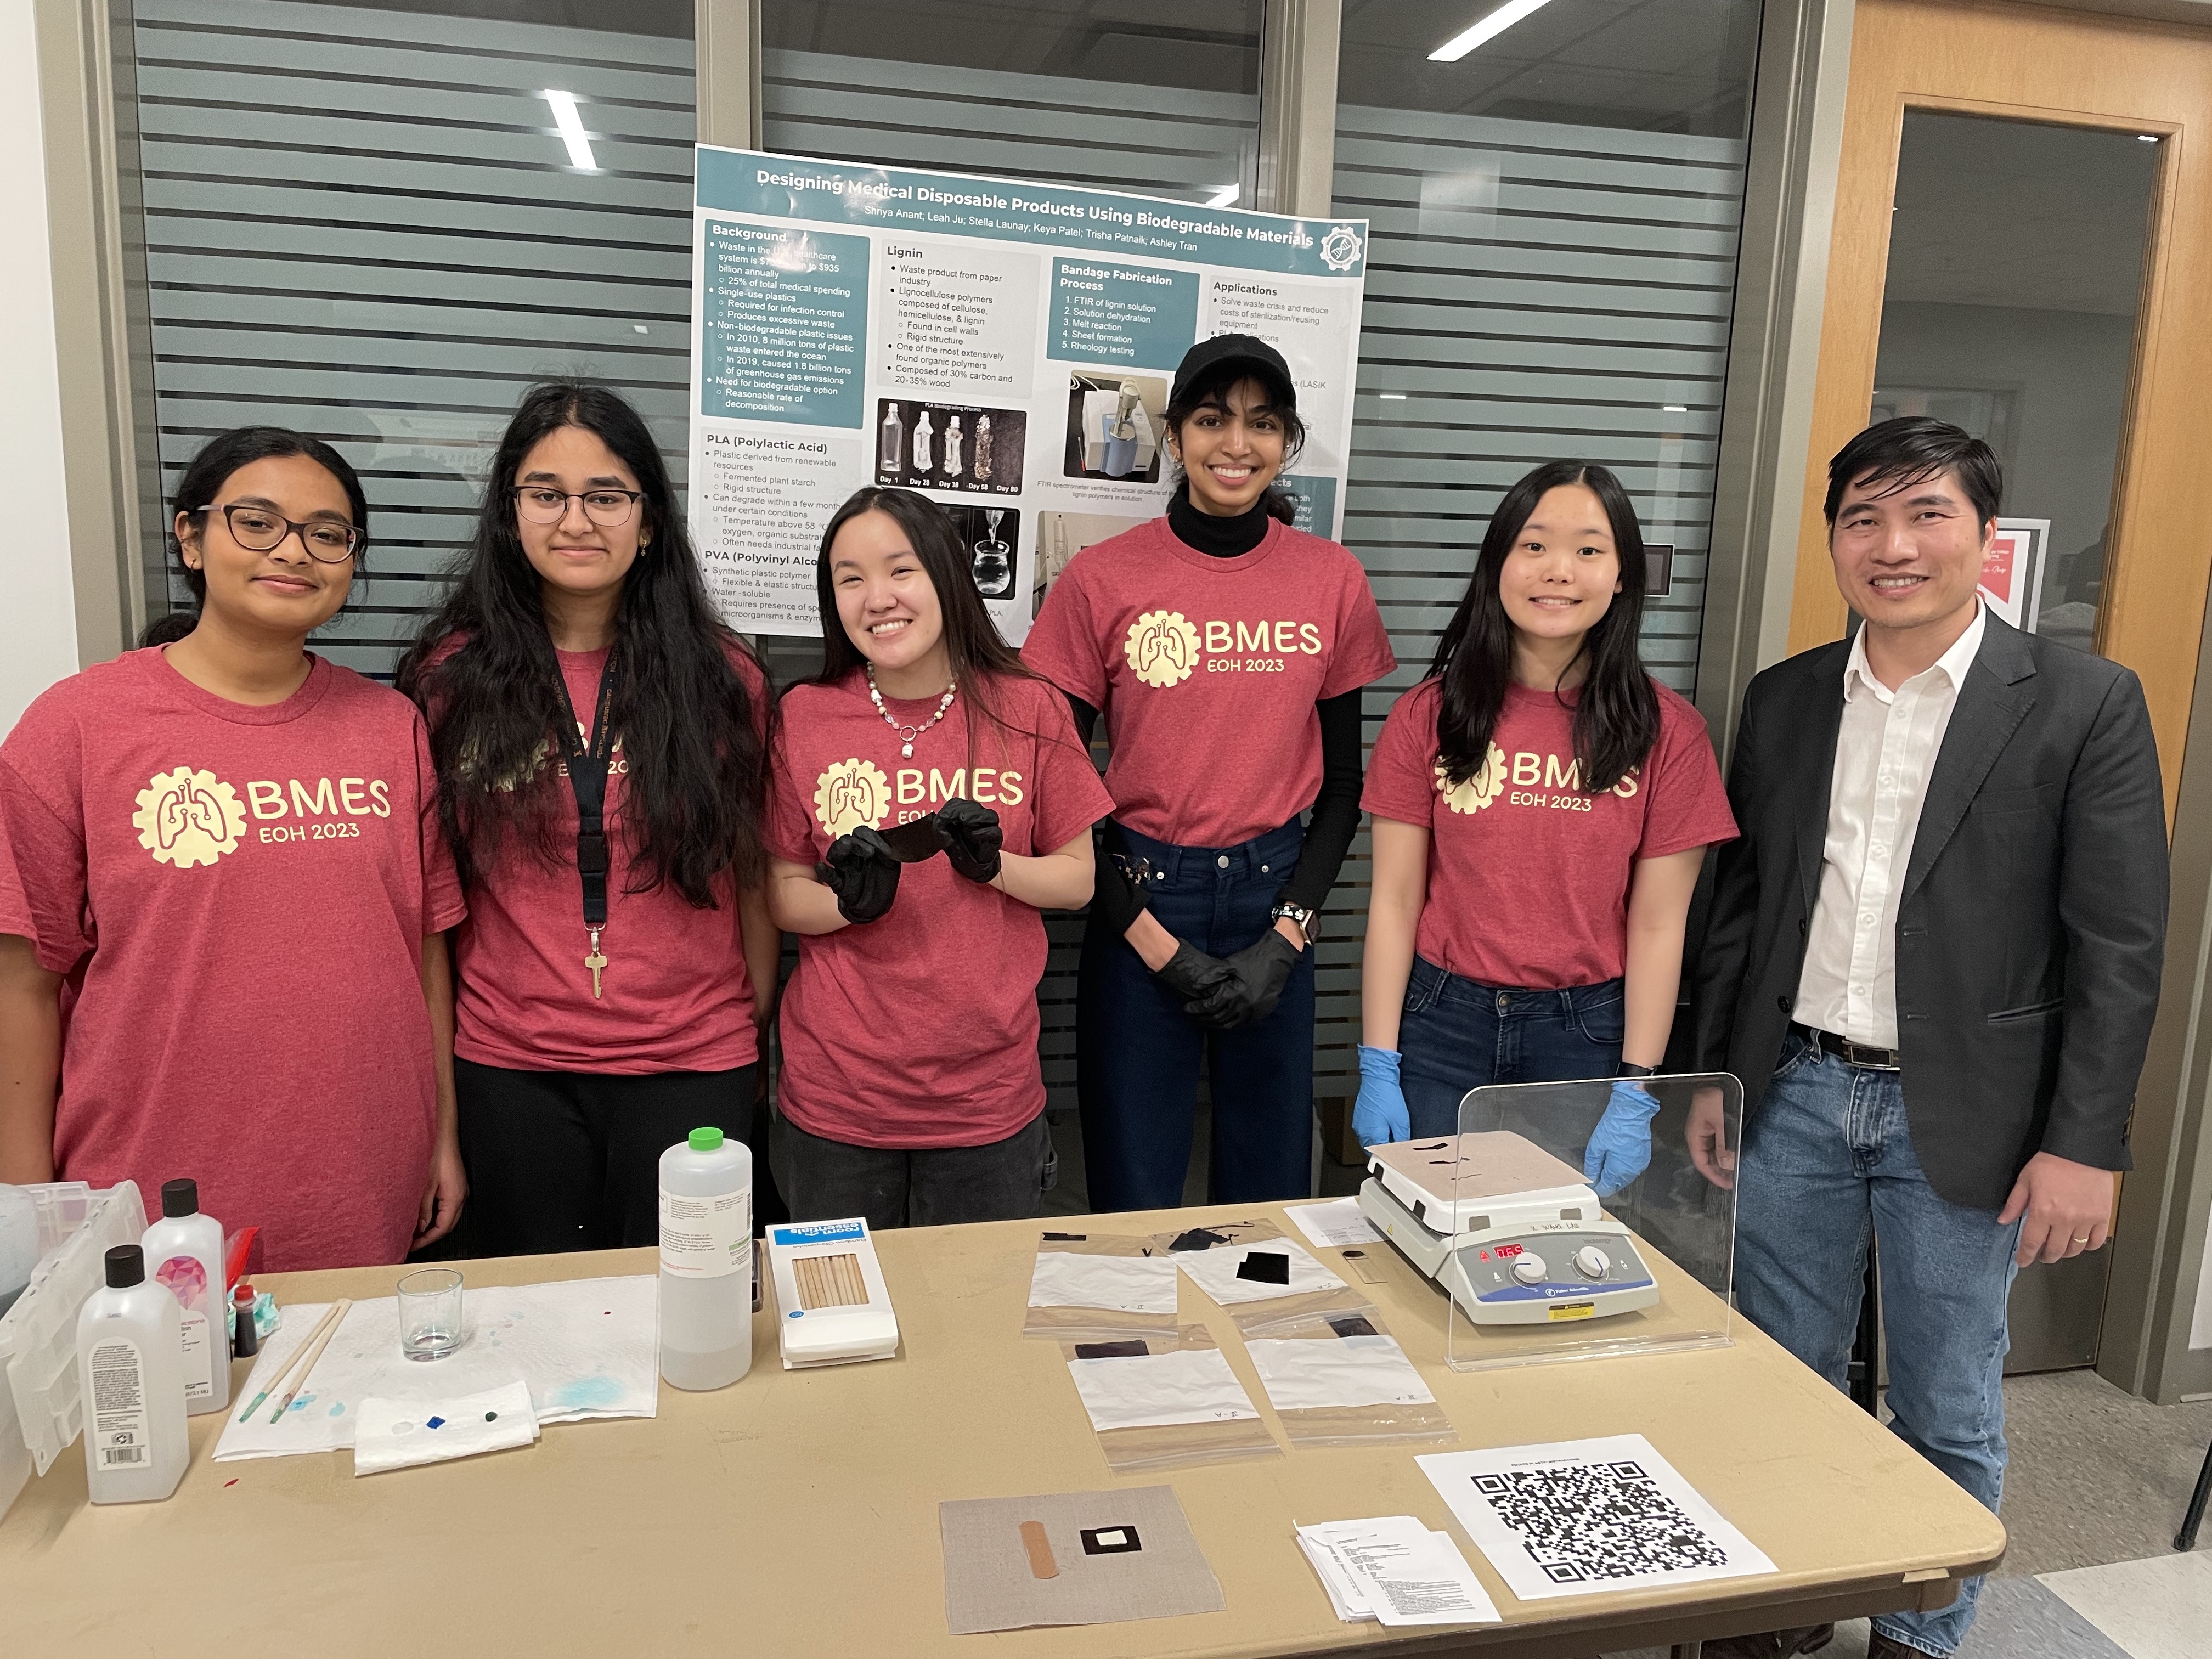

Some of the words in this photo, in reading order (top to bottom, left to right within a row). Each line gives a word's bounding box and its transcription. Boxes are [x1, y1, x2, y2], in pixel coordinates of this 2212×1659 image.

[757, 170, 843, 194] Designing
[848, 180, 912, 199] Medical
[917, 187, 1007, 209] Disposable
[1011, 198, 1084, 218] Products
[1089, 206, 1132, 227] Using
[1137, 212, 1243, 238] Biodegradable
[1246, 227, 1313, 249] Materials
[713, 225, 787, 242] Background
[865, 205, 893, 218] Shriya
[895, 208, 924, 221] Anant;
[928, 212, 950, 222] Leah
[952, 215, 966, 225] Ju;
[969, 217, 994, 227] Stella
[996, 219, 1031, 233] Launay;
[1034, 223, 1056, 235] Keya
[1058, 225, 1083, 238] Patel;
[1086, 229, 1112, 240] Trisha
[1114, 232, 1148, 246] Patnaik;
[1149, 237, 1177, 250] Ashley
[1179, 240, 1197, 251] Tran
[887, 246, 922, 258] Lignin
[718, 263, 742, 274] billion
[744, 268, 779, 279] annually
[900, 264, 925, 274] Waste
[927, 269, 957, 278] product
[960, 270, 977, 279] from
[979, 274, 1002, 283] paper
[1061, 264, 1110, 279] Bandage
[1113, 270, 1172, 285] Fabrication
[728, 276, 747, 286] 25%
[759, 280, 777, 289] total
[779, 283, 811, 292] medical
[813, 286, 850, 298] spending
[899, 276, 930, 287] industry
[1060, 278, 1103, 291] Process
[1214, 281, 1277, 296] Applications
[718, 286, 763, 298] Single-use
[765, 292, 796, 302] plastics
[899, 286, 955, 300] Lignocellulose
[957, 294, 992, 303] polymers
[1221, 297, 1241, 306] Solve
[727, 299, 765, 310] Required
[767, 303, 779, 311] for
[781, 304, 815, 315] infection
[817, 309, 844, 318] control
[899, 300, 939, 309] composed
[951, 304, 987, 315] cellulose,
[1066, 295, 1071, 303] 1.
[1074, 296, 1093, 306] FTIR
[1095, 298, 1104, 307] of
[1105, 300, 1125, 309] lignin
[1127, 303, 1156, 312] solution
[727, 310, 766, 321] Produces
[769, 316, 809, 325] excessive
[811, 320, 835, 328] waste
[1073, 307, 1104, 318] Solution
[1107, 311, 1150, 323] dehydration
[717, 320, 797, 335] Non-biodegradable
[799, 329, 825, 338] plastic
[827, 331, 853, 341] issues
[1063, 318, 1070, 326] 3.
[1072, 319, 1089, 328] Melt
[1091, 323, 1122, 331] reaction
[1219, 320, 1257, 329] equipment
[907, 332, 927, 342] Rigid
[929, 336, 963, 345] structure
[1071, 330, 1094, 340] Sheet
[1097, 332, 1132, 343] formation
[1062, 340, 1067, 348] 5.
[1070, 341, 1108, 354] Rheology
[1109, 346, 1134, 357] testing
[896, 353, 918, 363] found
[921, 358, 949, 366] organic
[951, 360, 986, 369] polymers
[736, 369, 785, 379] greenhouse
[804, 375, 844, 385] emissions
[895, 375, 927, 385] 20-35%
[716, 376, 738, 386] Need
[740, 378, 752, 387] for
[753, 380, 811, 392] biodegradable
[813, 387, 838, 395] option
[726, 388, 775, 400] Reasonable
[725, 399, 784, 411] decomposition
[707, 435, 730, 444] PLA
[734, 436, 794, 449] (Polylactic
[798, 442, 827, 455] Acid)
[713, 462, 753, 471] resources
[714, 450, 741, 459] Plastic
[743, 453, 772, 461] derived
[775, 455, 793, 463] from
[795, 458, 836, 467] renewable
[723, 472, 766, 483] Fermented
[769, 476, 789, 484] plant
[791, 478, 815, 487] starch
[879, 476, 891, 484] Day
[723, 483, 743, 493] Rigid
[746, 486, 781, 494] structure
[768, 510, 808, 518] conditions
[705, 551, 729, 560] PVA
[733, 552, 789, 566] (Polyvinyl
[712, 566, 749, 575] Synthetic
[779, 571, 811, 580] polymer
[1206, 620, 1322, 654] BMES
[1207, 659, 1241, 673] EOH
[1246, 659, 1284, 672] 2023
[1513, 752, 1639, 798] BMS
[897, 768, 1023, 805] BMES
[247, 778, 391, 819] BMES
[1510, 792, 1546, 807] EOH
[1551, 796, 1592, 812] 2023
[259, 826, 306, 844] EOH
[311, 823, 360, 840] 2023
[790, 1223, 859, 1234] essentials
